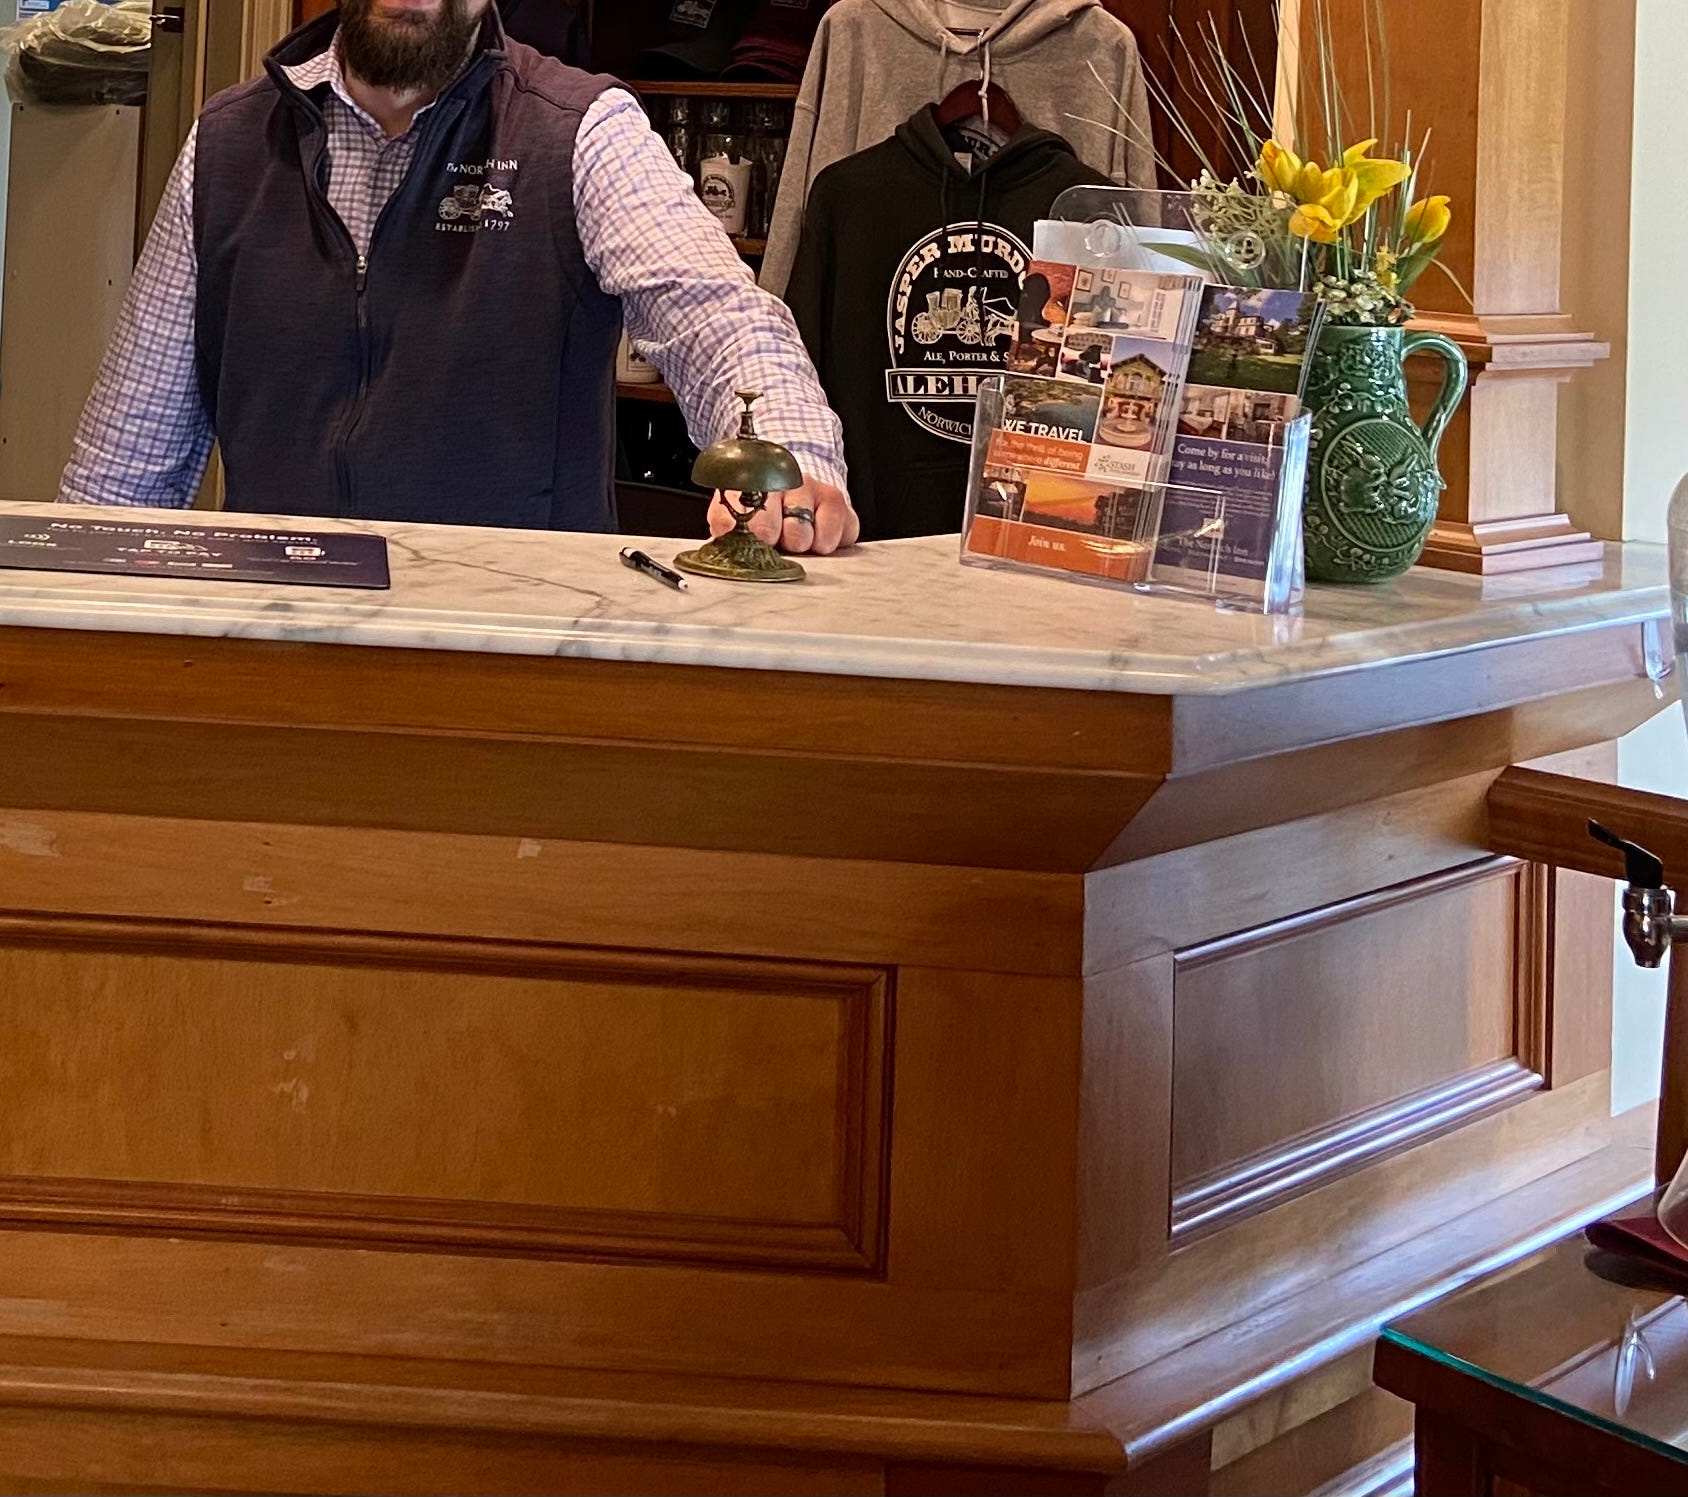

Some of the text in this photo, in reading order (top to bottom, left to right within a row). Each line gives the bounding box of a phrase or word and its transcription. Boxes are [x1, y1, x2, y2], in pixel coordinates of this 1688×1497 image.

[497, 159, 518, 171] INN
[484, 218, 510, 231] 1797
[895, 242, 941, 354] JASPER
[989, 350, 1001, 363] &
[895, 375, 979, 395] ALEH
[1003, 418, 1088, 444] WE TRAVEL
[1177, 443, 1206, 457] Come
[1207, 446, 1220, 461] by
[1221, 448, 1236, 459] for
[1043, 456, 1081, 470] different
[1187, 461, 1198, 470] as
[1199, 459, 1222, 476] long
[1222, 466, 1233, 475] as
[1234, 467, 1252, 478] you
[173, 529, 206, 537] No
[1027, 535, 1050, 550] Join
